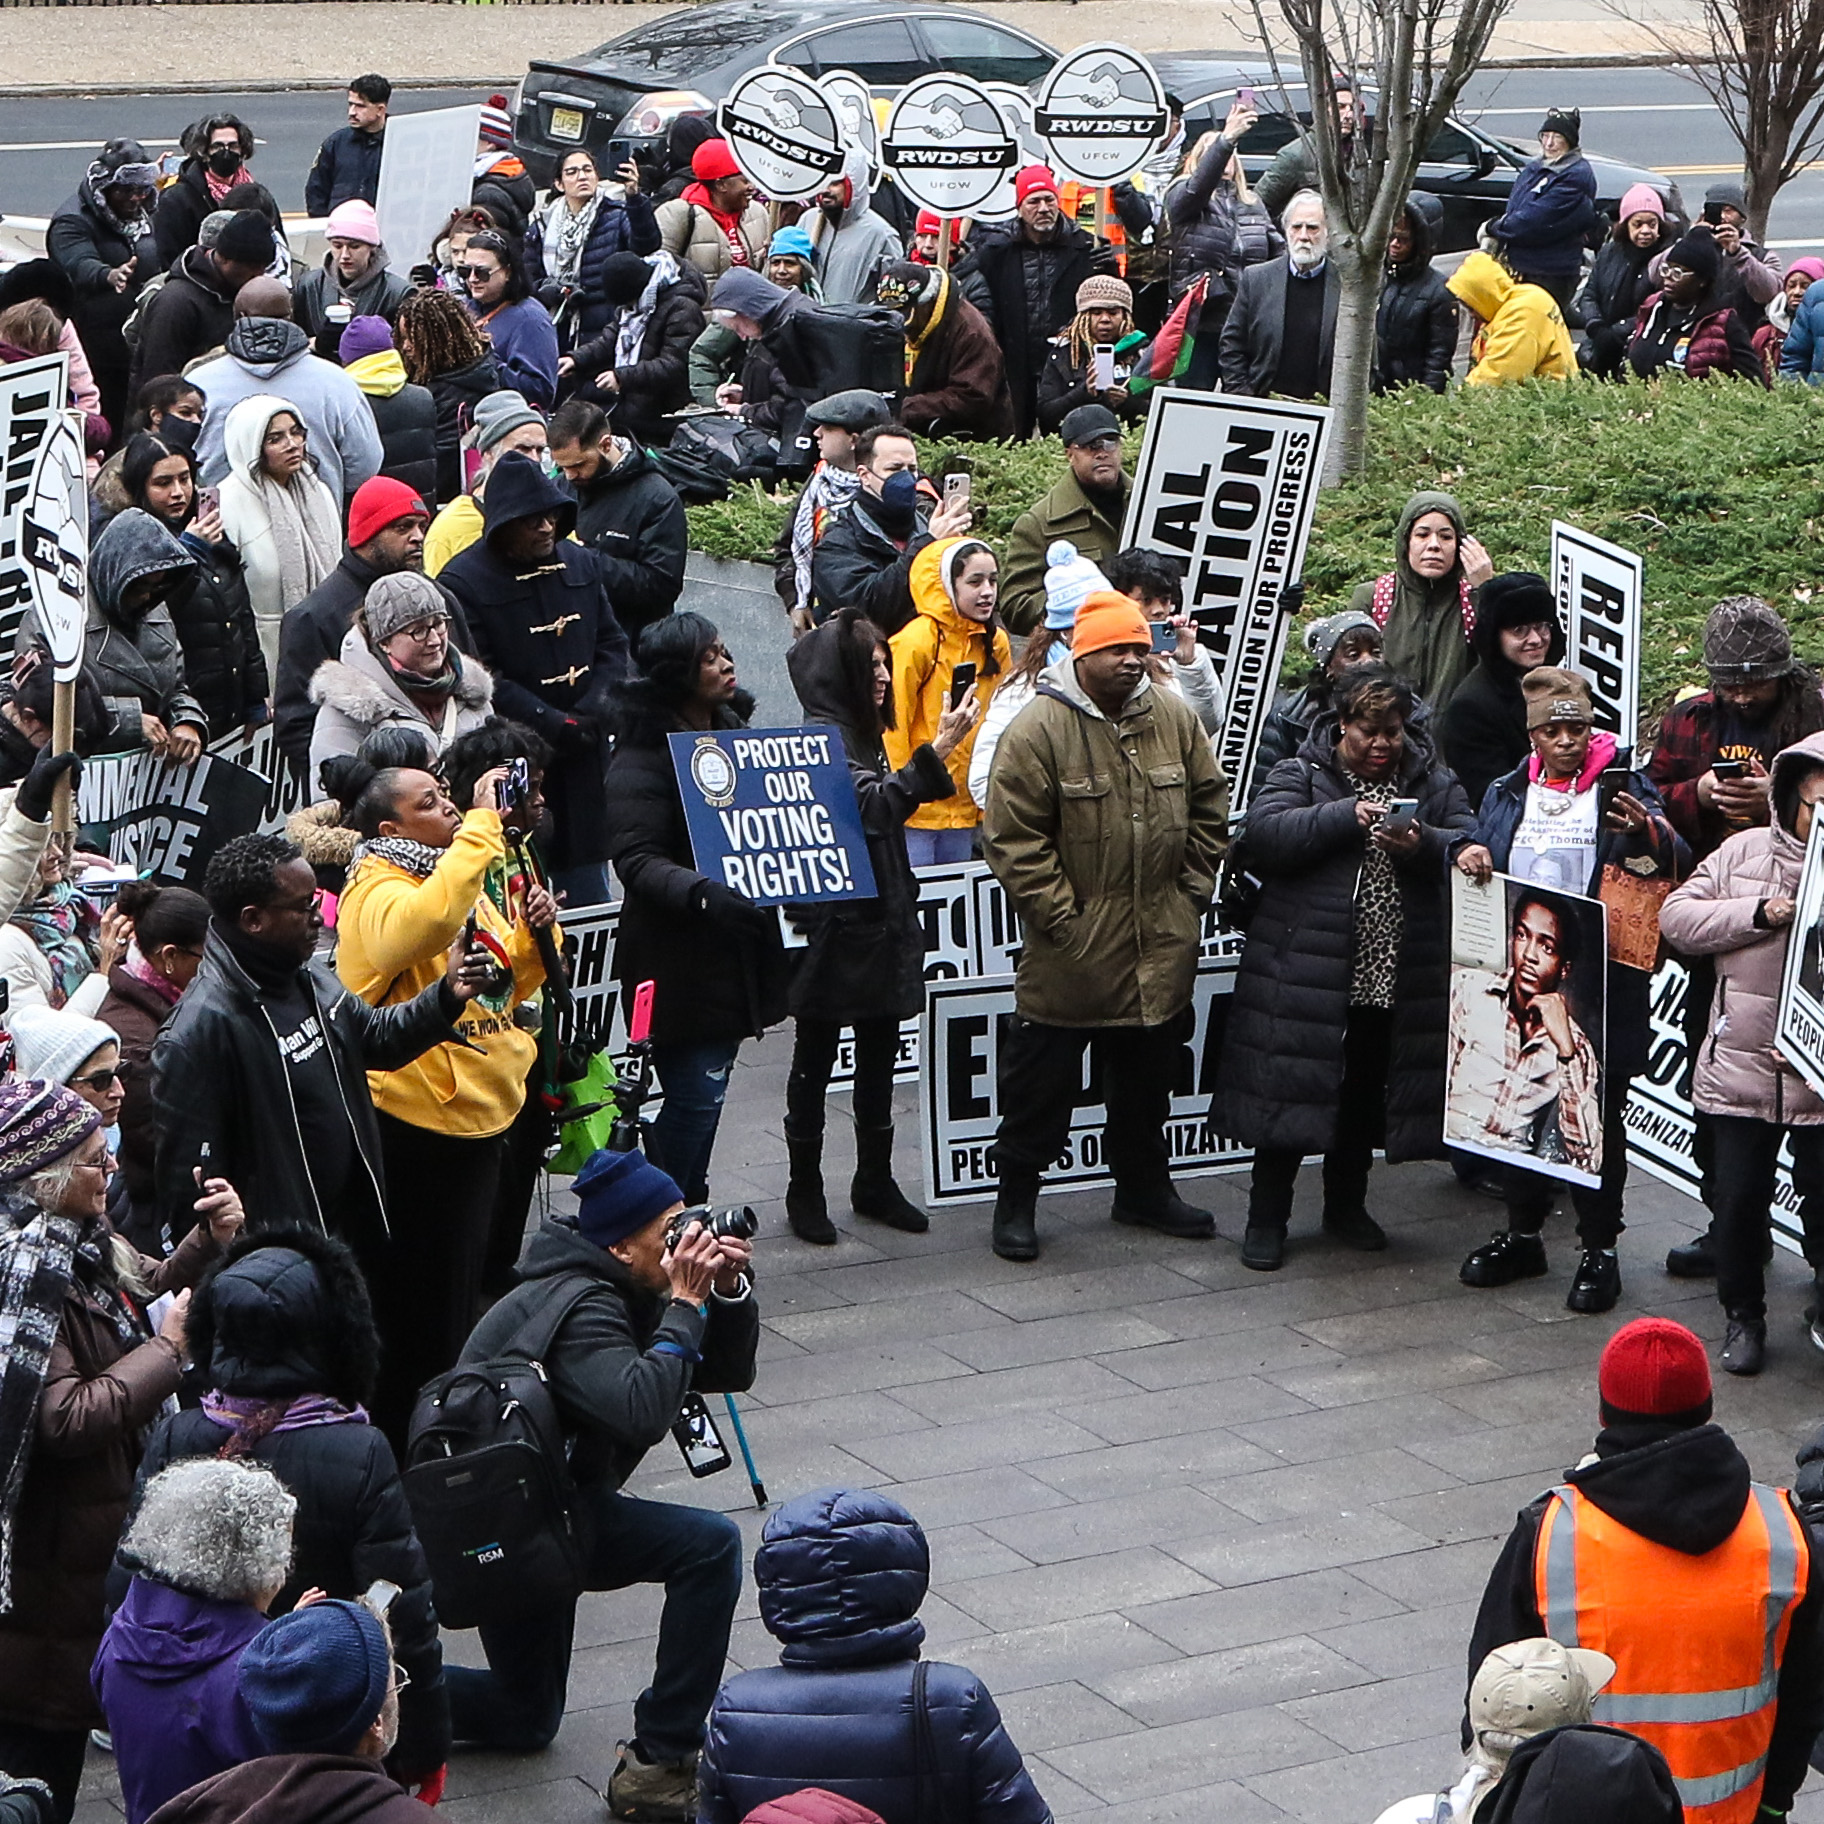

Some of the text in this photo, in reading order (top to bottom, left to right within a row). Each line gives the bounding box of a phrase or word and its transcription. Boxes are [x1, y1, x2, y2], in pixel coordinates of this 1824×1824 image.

[732, 120, 831, 166] RWDSU
[1048, 119, 1155, 134] RWDSU
[895, 150, 1005, 166] RWDSU
[1082, 151, 1121, 161] UFCW
[930, 180, 971, 190] UFCW
[3, 390, 51, 517] JAIL
[1262, 431, 1312, 577] PROGRESS
[1250, 580, 1278, 630] FOR
[733, 735, 830, 769] PROTECT
[764, 771, 815, 803] OUR
[719, 804, 835, 851] VOTING
[1550, 835, 1597, 845] Thomas
[721, 847, 854, 899] RIGHTS!
[477, 1547, 504, 1564] RSM
